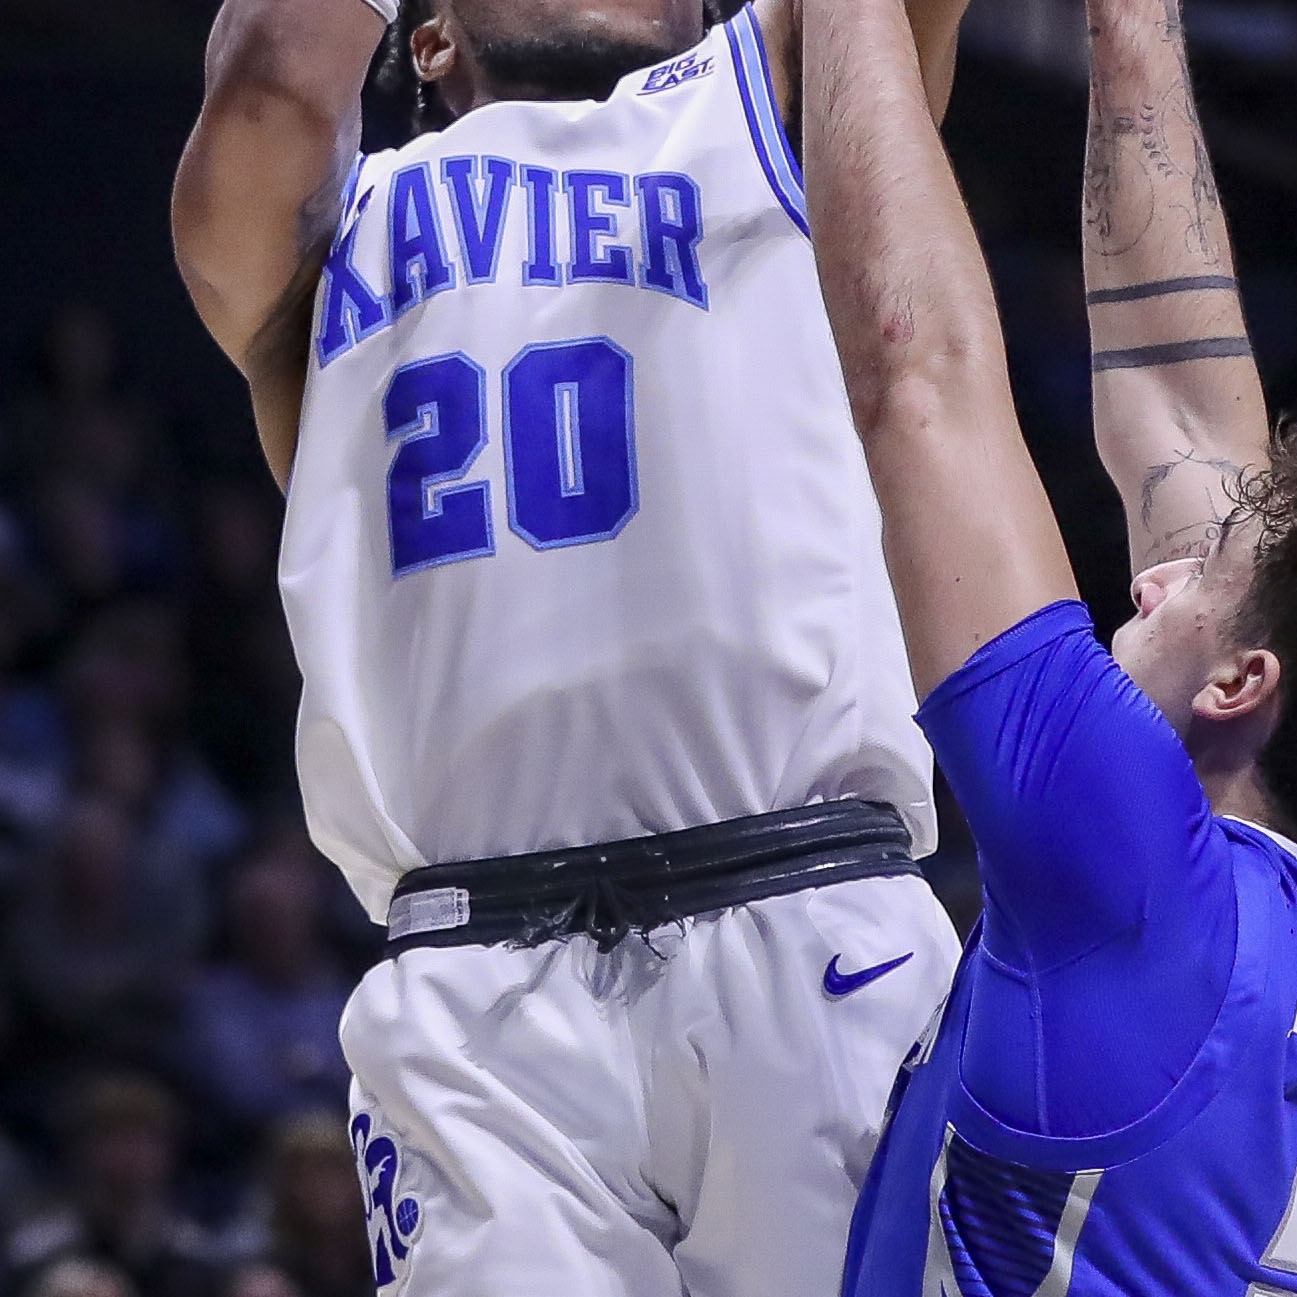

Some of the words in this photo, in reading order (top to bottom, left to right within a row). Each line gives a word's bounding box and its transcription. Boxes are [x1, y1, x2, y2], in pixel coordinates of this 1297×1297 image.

[649, 52, 697, 78] BIG
[317, 154, 710, 368] XAVIER
[382, 336, 639, 578] 20
